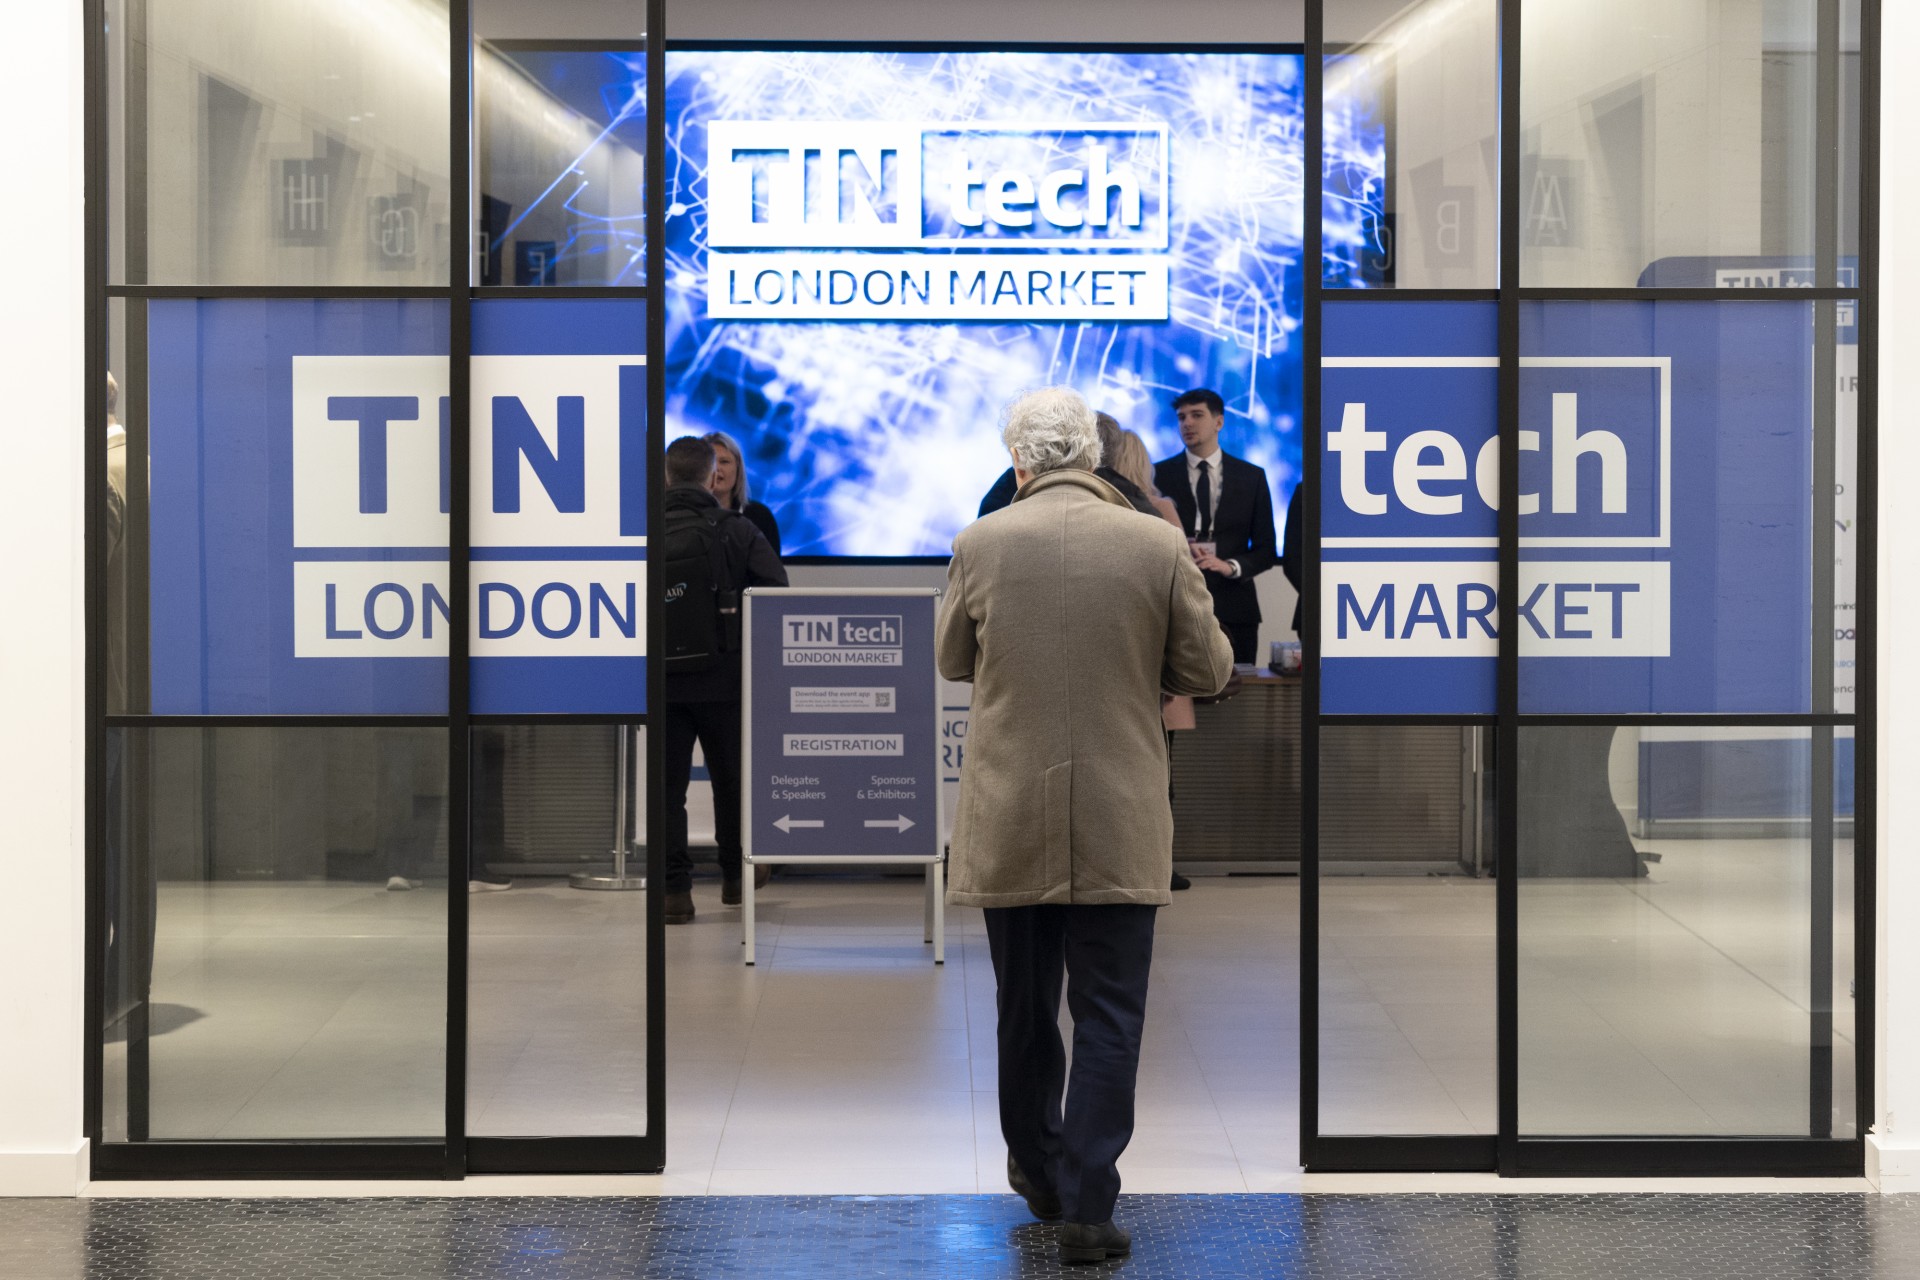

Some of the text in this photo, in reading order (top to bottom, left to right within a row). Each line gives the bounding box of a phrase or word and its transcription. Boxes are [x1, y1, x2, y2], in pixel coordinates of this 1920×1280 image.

[731, 144, 1141, 229] TIN tech
[728, 268, 1146, 306] LONDON MARKET
[1327, 393, 1627, 515] tech
[325, 582, 636, 640] LONDON
[788, 621, 896, 643] TIN tech
[787, 652, 897, 663] LONDON MARKET
[790, 739, 897, 751] REGISTRATION
[771, 775, 820, 786] Delegates
[871, 775, 916, 787] Sponsors
[772, 789, 826, 801] & Speakers
[857, 789, 916, 800] & Exhibitors
